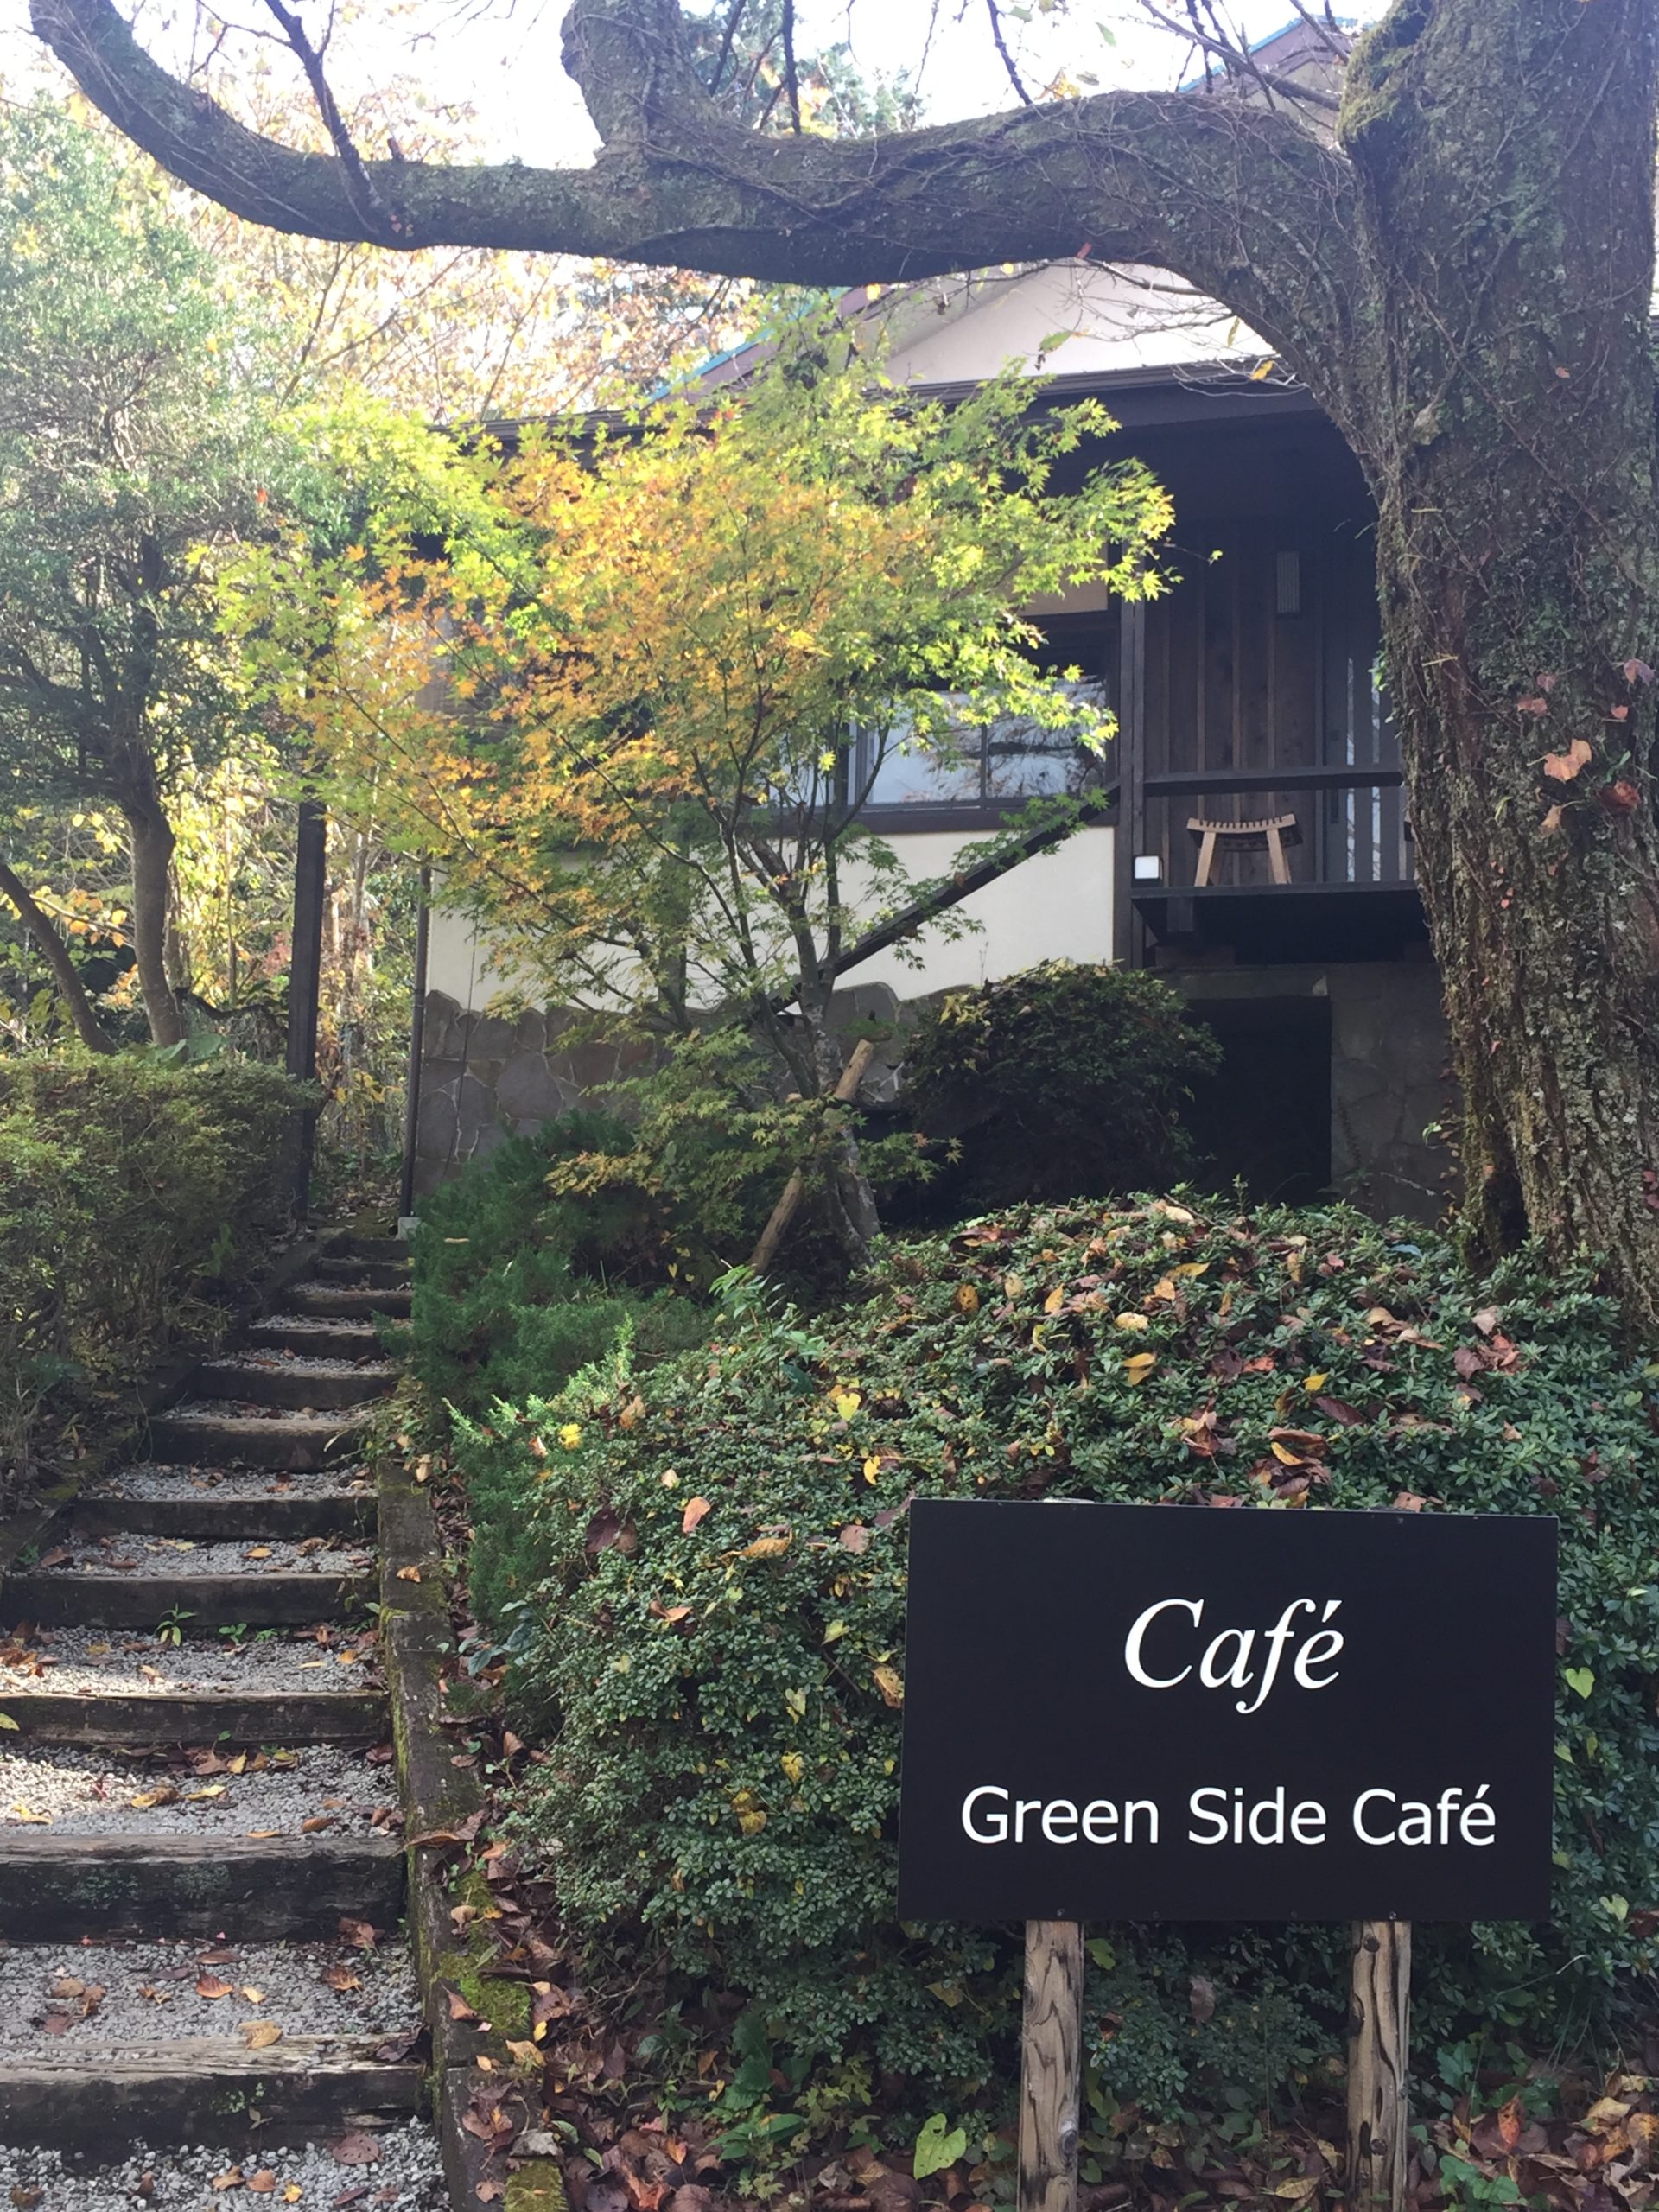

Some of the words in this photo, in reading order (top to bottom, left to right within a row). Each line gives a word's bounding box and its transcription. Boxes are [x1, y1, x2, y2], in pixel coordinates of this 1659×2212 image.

[1124, 1598, 1344, 1714] Café
[961, 1785, 1159, 1844] Green
[1188, 1786, 1326, 1845] Side
[1352, 1784, 1496, 1846] Café
